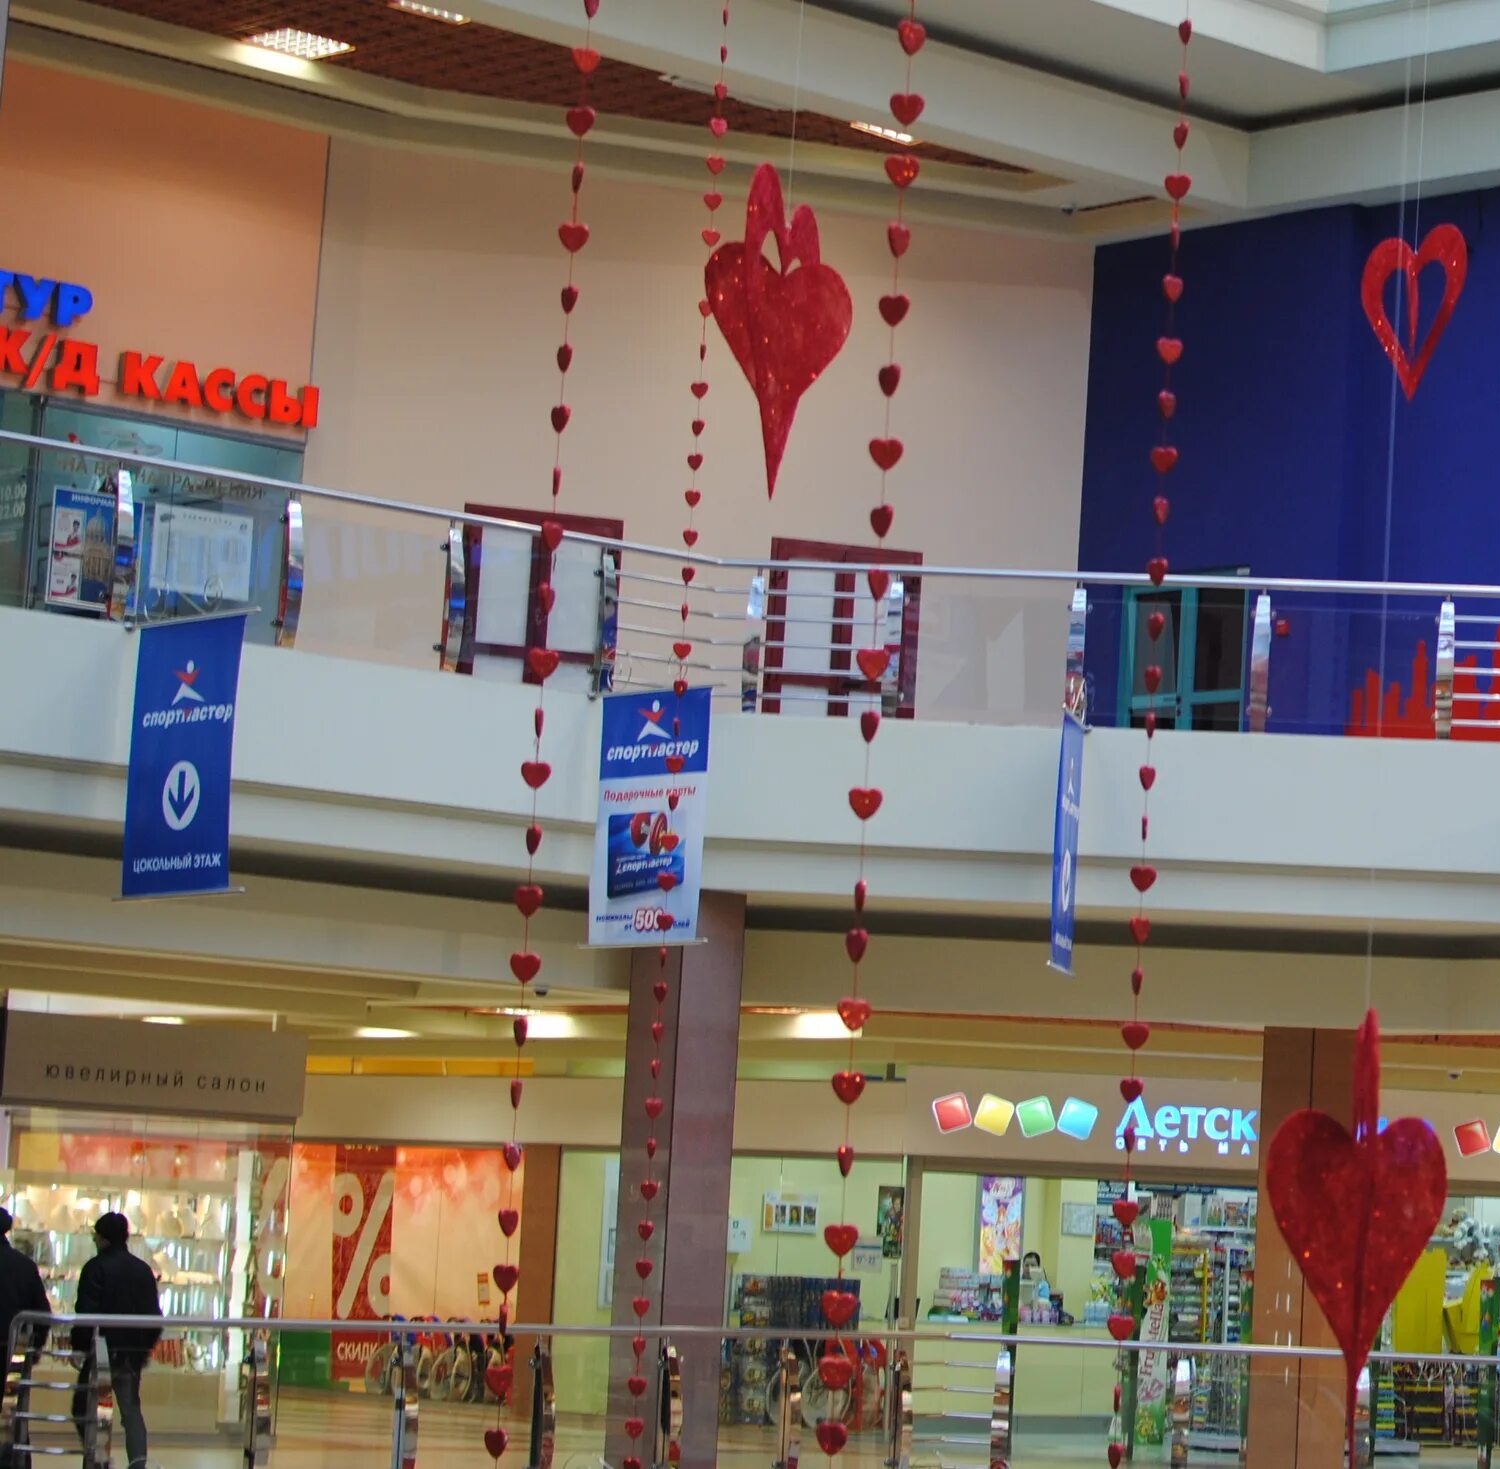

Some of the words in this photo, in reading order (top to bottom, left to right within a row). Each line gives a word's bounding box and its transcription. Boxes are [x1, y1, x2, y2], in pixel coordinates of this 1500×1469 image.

[122, 351, 319, 428] КАССЫ
[143, 704, 233, 728] спортмастер
[607, 739, 699, 762] спортмастер
[603, 788, 664, 804] Подарочные
[133, 853, 192, 873] ЦОКОЛЬНЫЙ
[193, 852, 221, 869] ЭТАЖ
[45, 1063, 184, 1088] ювелирный
[196, 1075, 266, 1093] салон
